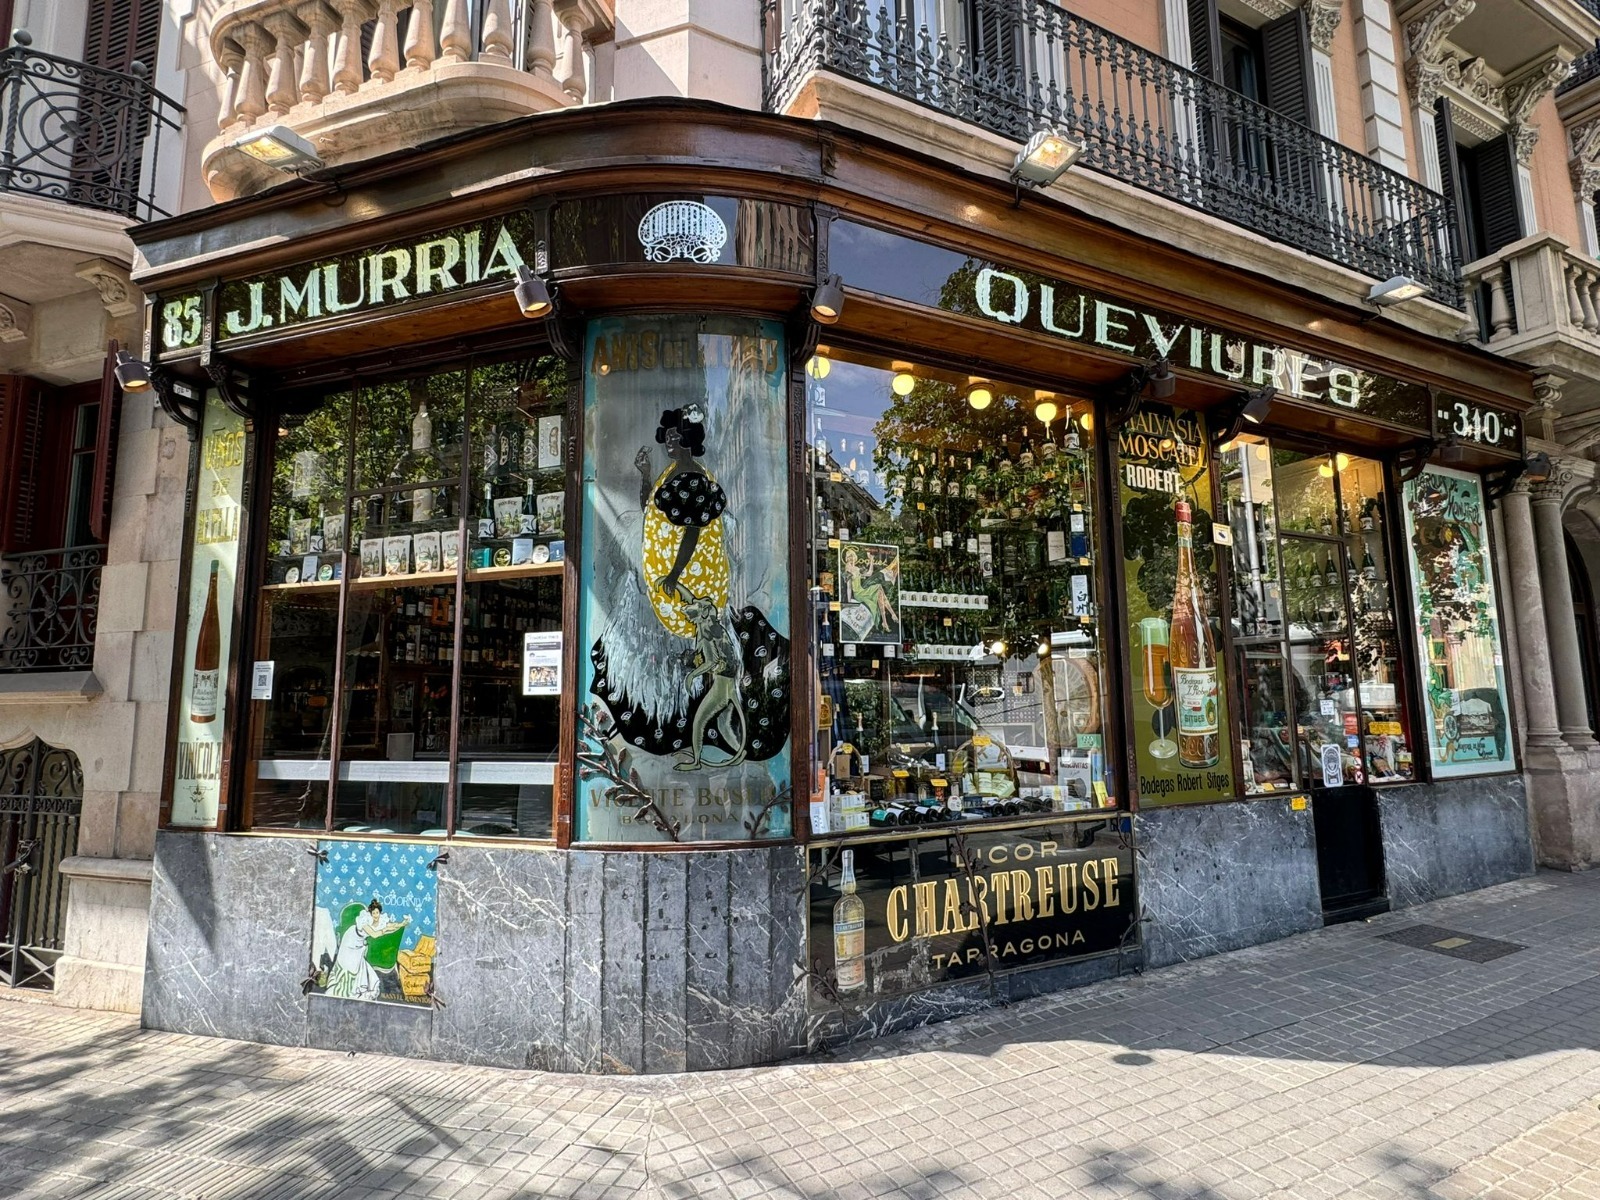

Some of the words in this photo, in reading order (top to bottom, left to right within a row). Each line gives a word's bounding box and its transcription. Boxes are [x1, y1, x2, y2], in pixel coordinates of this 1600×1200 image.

[227, 224, 524, 333] J.MURRIA
[163, 295, 203, 348] 85
[974, 268, 1360, 409] QUEVIURES
[663, 340, 692, 368] DEL
[1118, 432, 1208, 468] MOSCATEL
[1126, 463, 1181, 494] ROBERT
[1140, 776, 1175, 797] Bodegas
[1177, 773, 1203, 793] Robert
[1206, 772, 1230, 792] Sitges
[622, 813, 740, 825] BAALONA
[955, 840, 1059, 868] LICOR
[886, 857, 1121, 942] CHARTREUSE
[931, 930, 1086, 970] TARRAGONA
